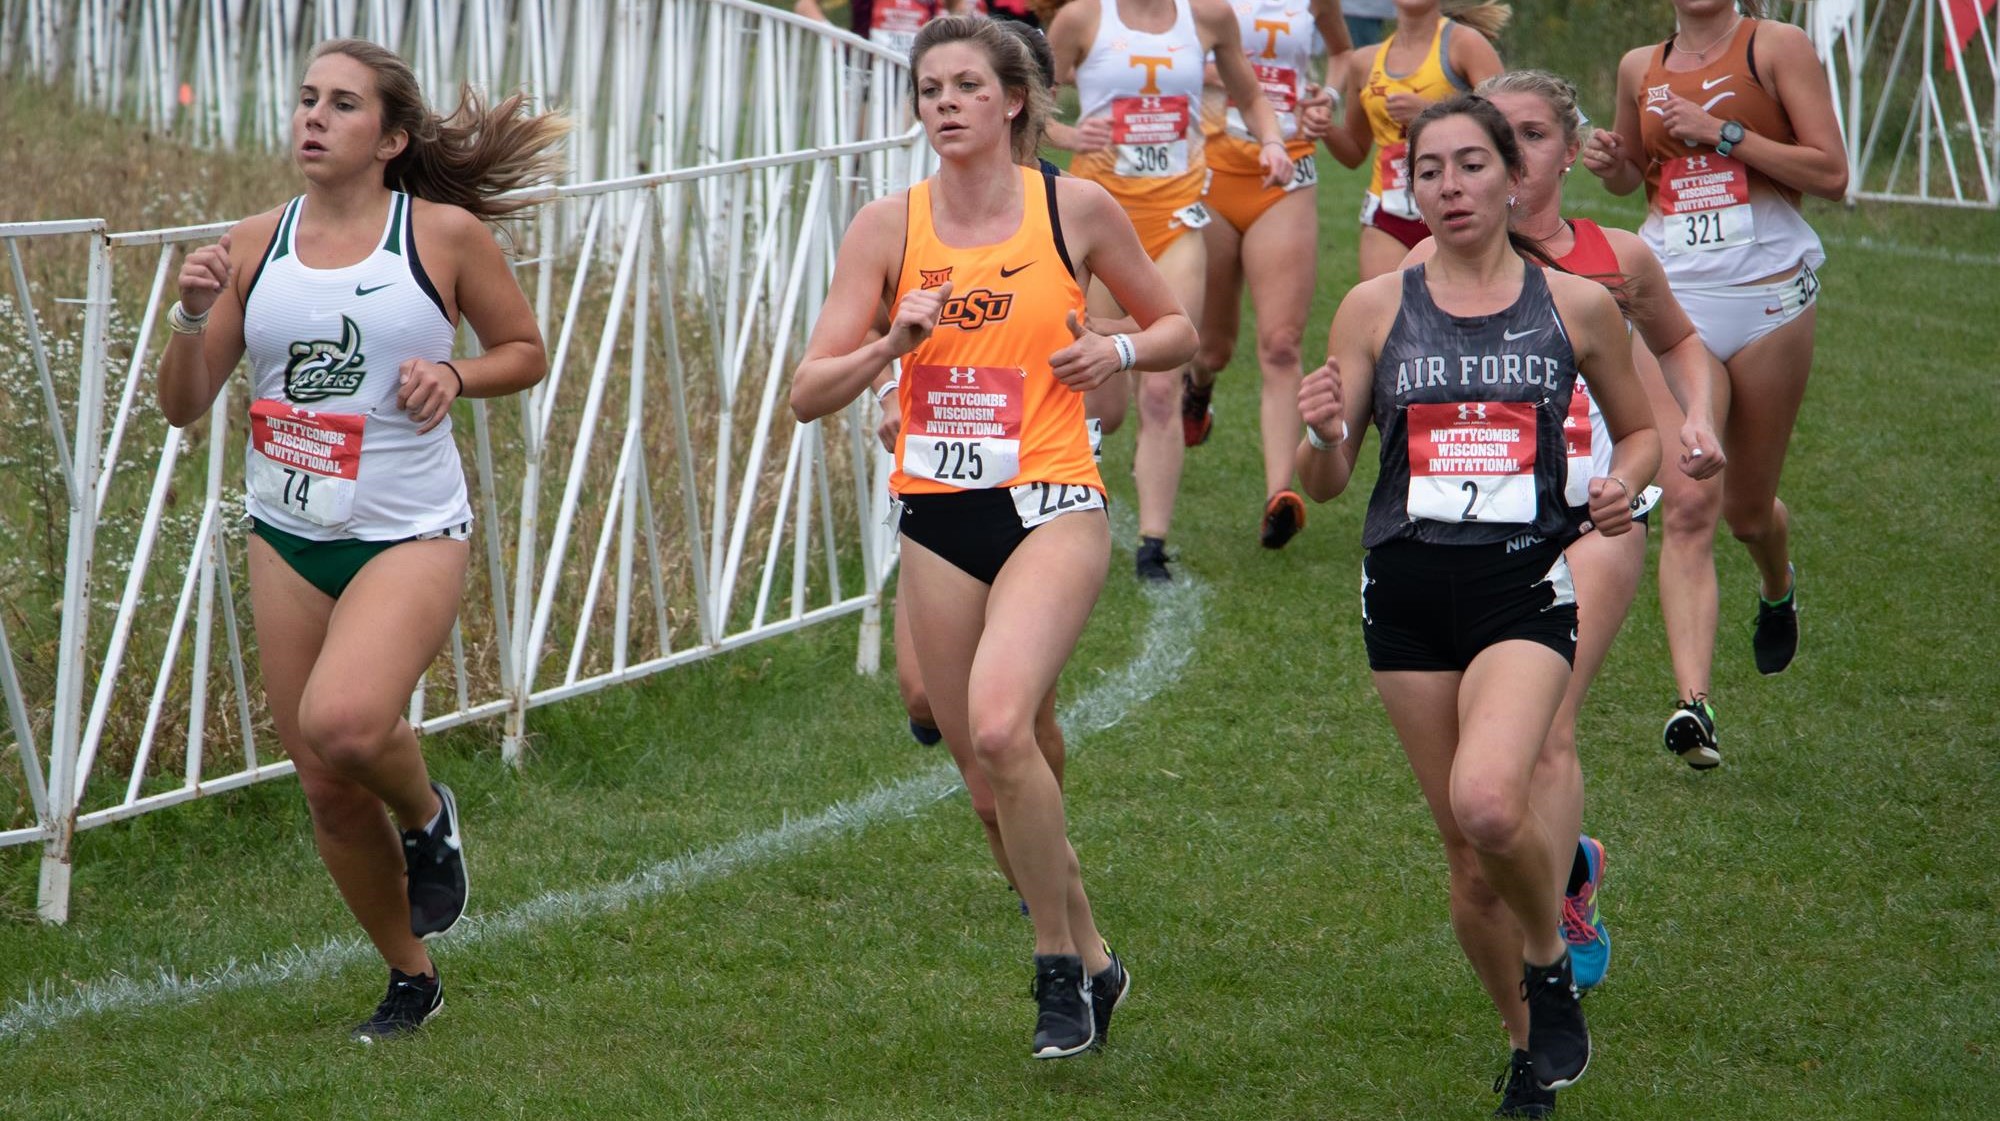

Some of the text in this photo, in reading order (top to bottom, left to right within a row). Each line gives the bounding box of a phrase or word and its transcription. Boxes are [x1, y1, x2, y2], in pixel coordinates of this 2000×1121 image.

[1254, 19, 1290, 58] T
[1130, 55, 1172, 94] T
[1134, 146, 1168, 172] 306
[1671, 171, 1734, 190] NUTTYCOMBE
[1677, 183, 1727, 199] WISCONSIN
[1673, 194, 1738, 212] INVITATIONAL
[1686, 212, 1725, 246] 321
[939, 289, 1013, 330] OSU
[295, 370, 361, 388] 49ERS
[1395, 354, 1559, 395] AIR FORCE
[927, 391, 1007, 407] NUTTYCOMBE
[933, 406, 994, 421] WISCONSIN
[266, 415, 346, 446] NUTTYCOMBE
[926, 420, 1006, 436] INVITATIONAL
[1430, 428, 1520, 443] NUTTYCOMBE
[264, 441, 342, 474] INVITATIONAL
[272, 430, 333, 459] WISCONSIN
[1437, 443, 1508, 457] WISCONSIN
[934, 440, 983, 480] 225
[1429, 457, 1520, 473] INVITATIONAL
[283, 468, 310, 511] 74
[1461, 480, 1478, 520] 2
